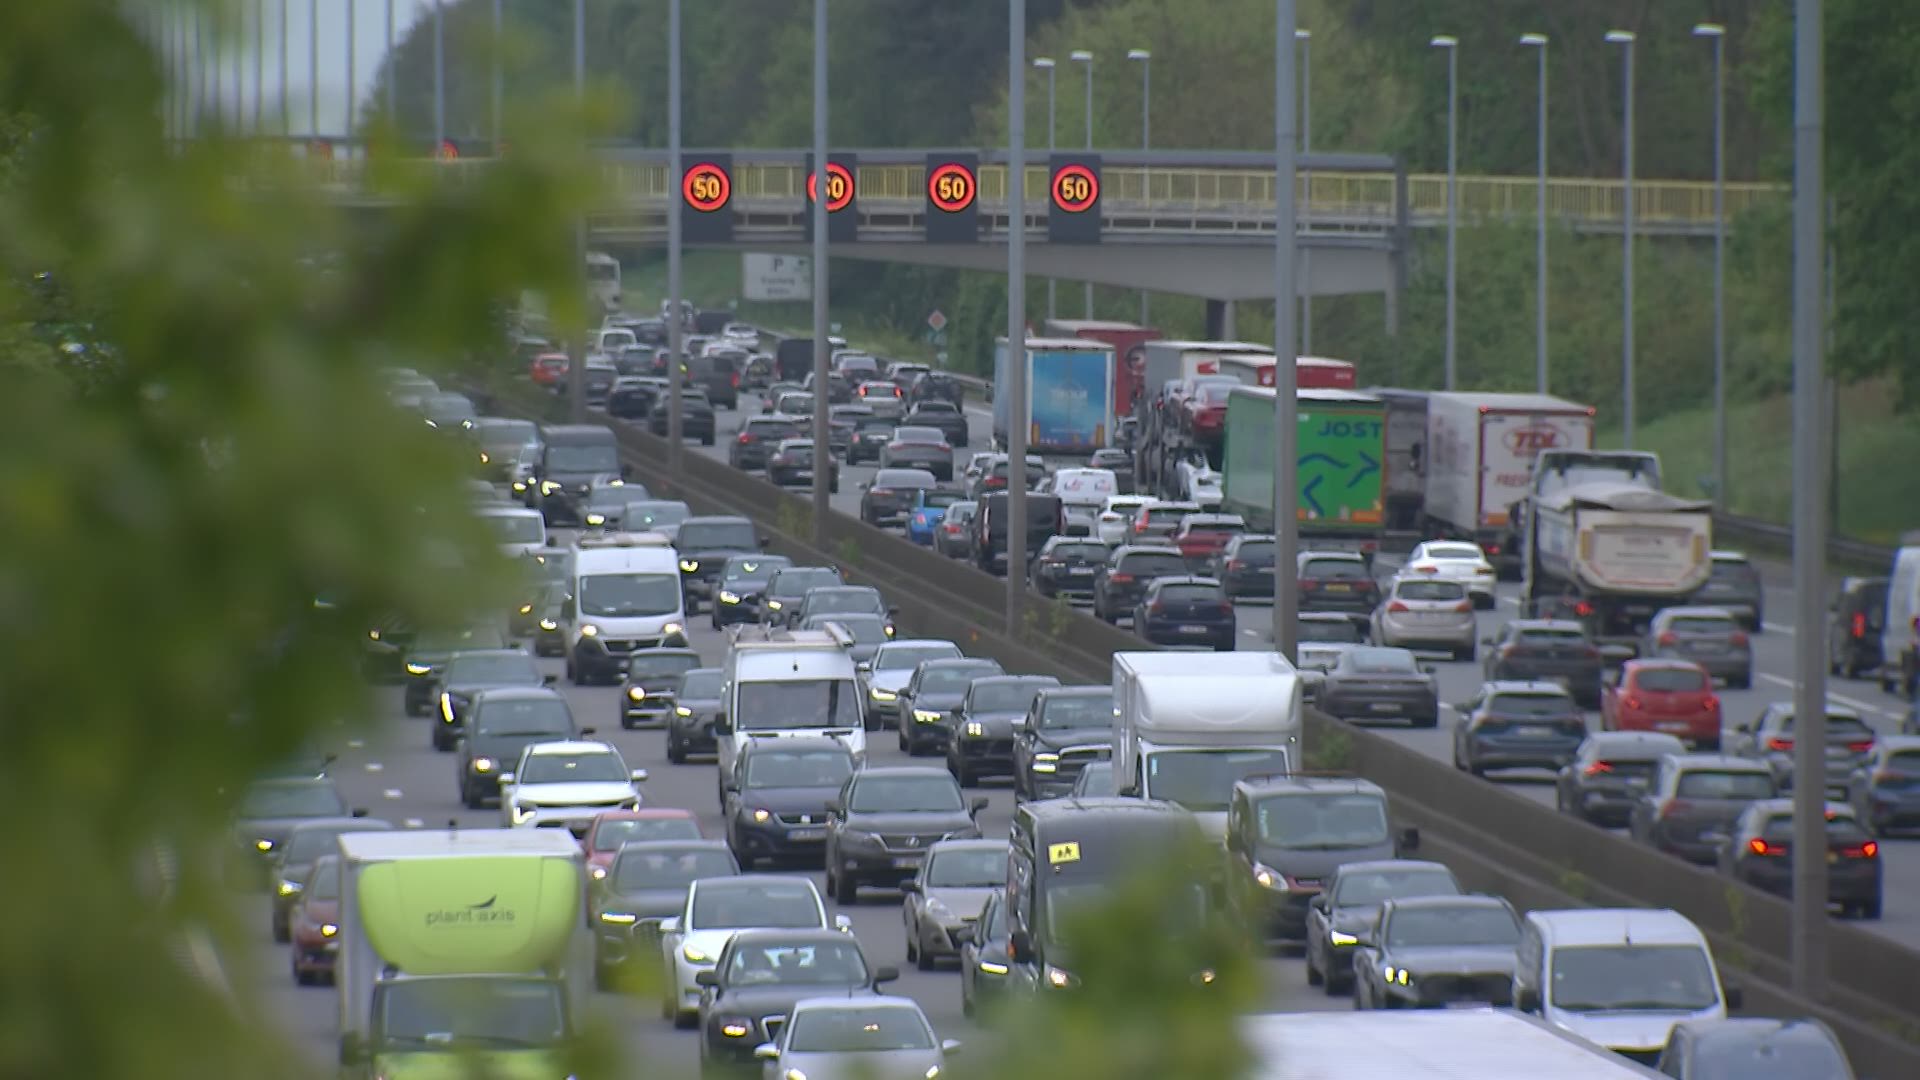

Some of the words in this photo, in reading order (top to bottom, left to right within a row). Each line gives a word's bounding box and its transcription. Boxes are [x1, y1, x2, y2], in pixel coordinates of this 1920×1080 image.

[693, 174, 720, 199] 50
[939, 176, 966, 200] 50
[1061, 176, 1089, 200] 50
[773, 257, 784, 272] P
[1317, 420, 1383, 439] JOST
[425, 908, 472, 927] plant
[478, 908, 516, 922] axis
